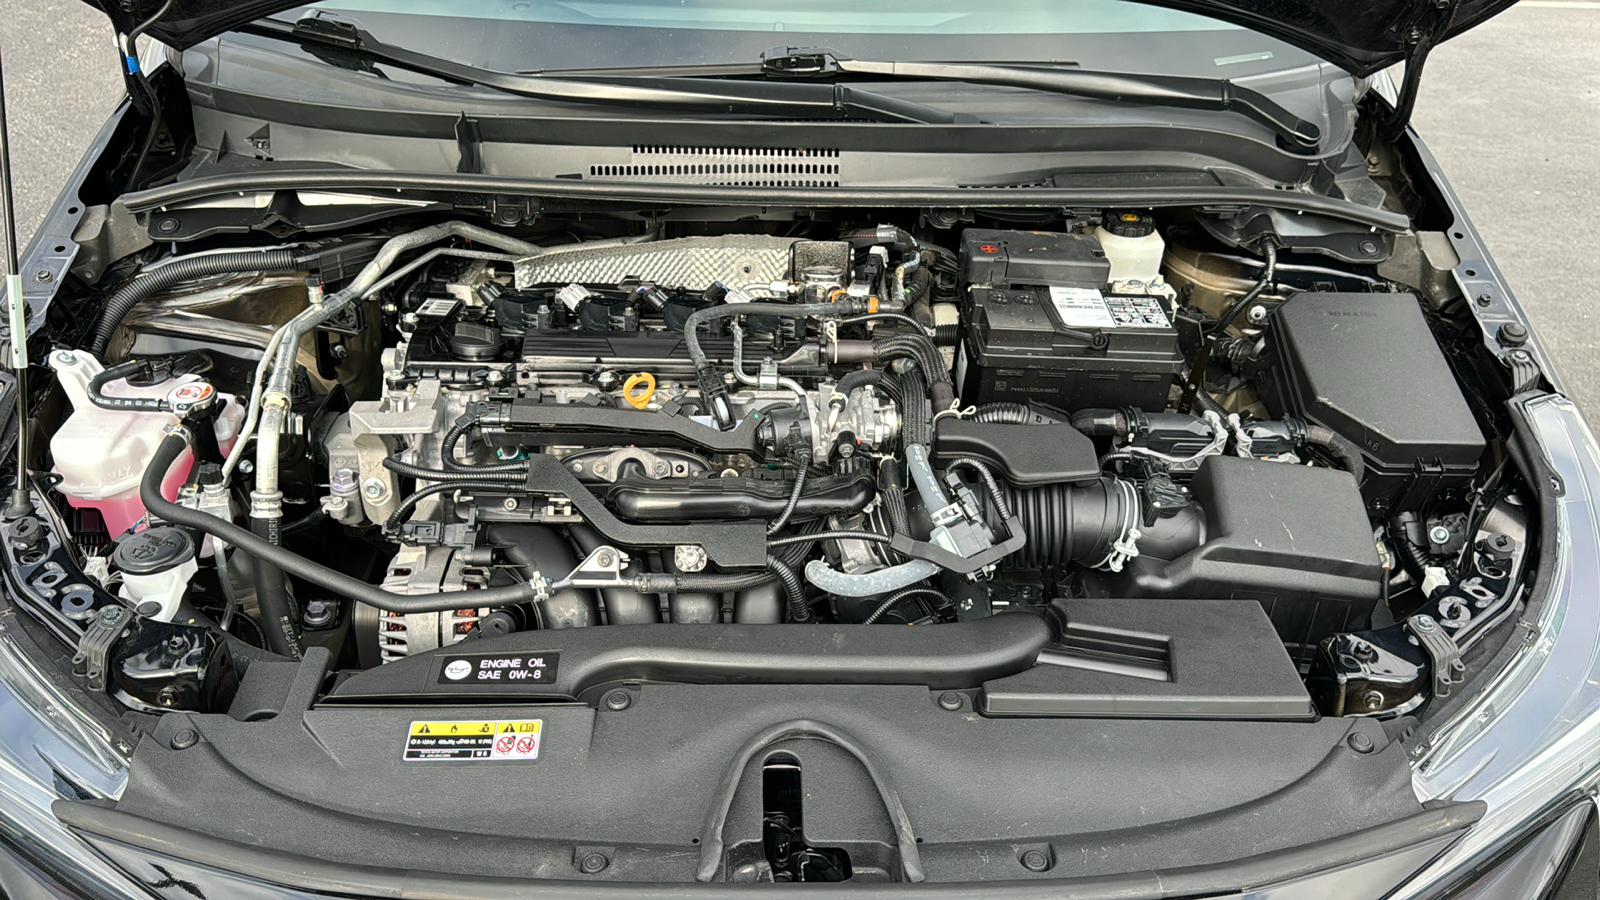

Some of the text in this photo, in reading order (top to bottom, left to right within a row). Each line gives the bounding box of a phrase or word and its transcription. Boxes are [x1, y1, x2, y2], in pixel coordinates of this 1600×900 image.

[480, 658, 547, 669] ENGINE OIL
[477, 670, 542, 680] SAE 0W-8
